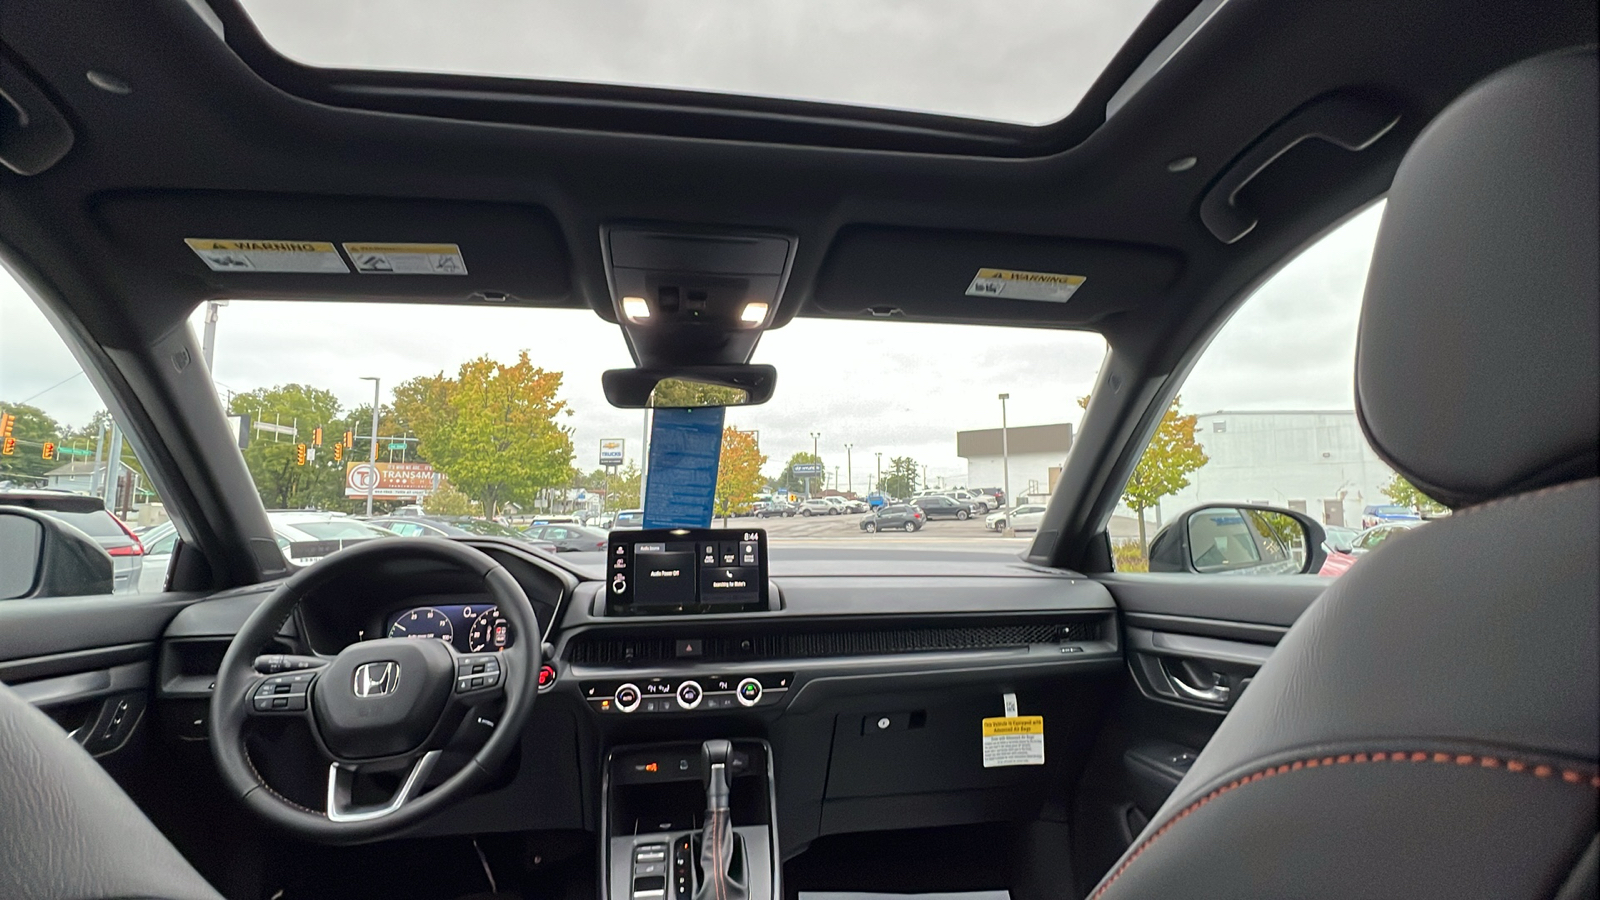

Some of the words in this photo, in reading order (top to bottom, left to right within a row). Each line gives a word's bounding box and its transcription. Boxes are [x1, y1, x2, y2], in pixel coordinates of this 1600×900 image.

[234, 242, 315, 252] WARNING
[1010, 272, 1068, 283] WARNING
[744, 532, 758, 541] 8:44
